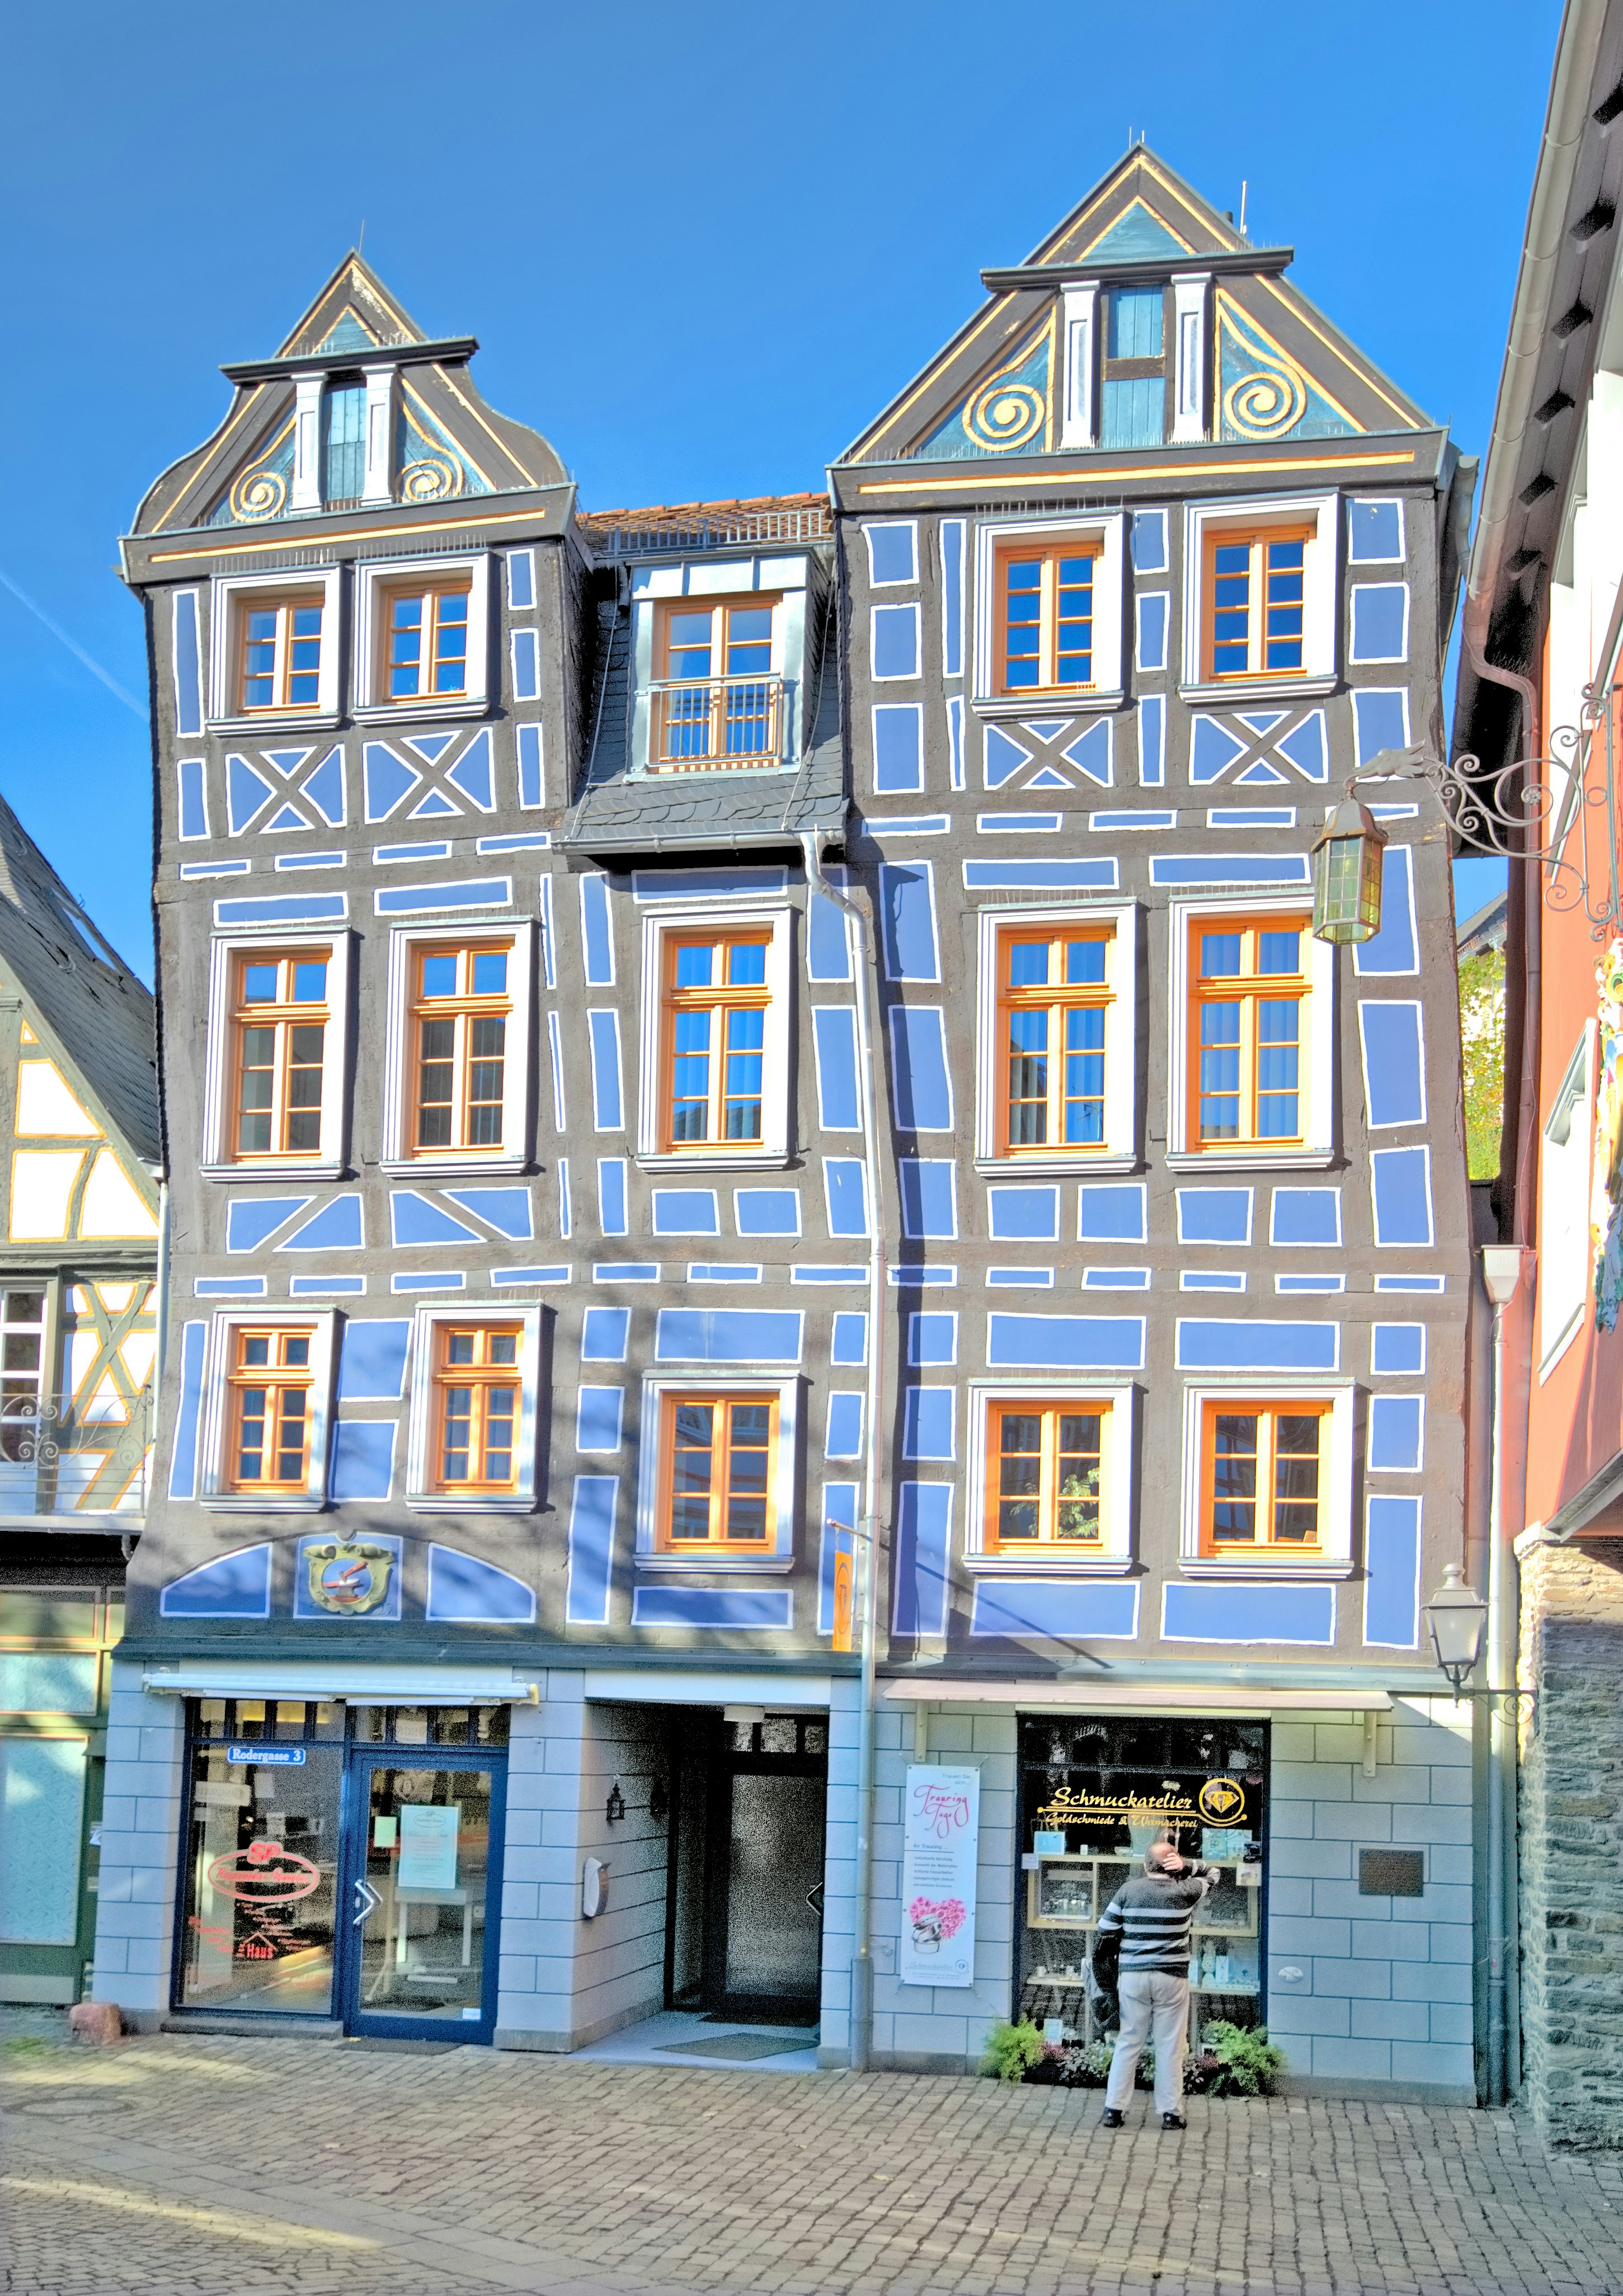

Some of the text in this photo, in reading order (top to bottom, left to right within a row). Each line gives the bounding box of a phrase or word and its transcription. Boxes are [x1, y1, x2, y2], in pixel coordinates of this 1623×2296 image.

[233, 1748, 301, 1762] Rodergasse 3
[912, 1784, 968, 1827] Trauring
[1050, 1786, 1192, 1809] Schmuckatelier
[924, 1802, 961, 1838] Tage
[1045, 1812, 1197, 1828] Goldschmiede & Uhrmacherei
[247, 1842, 281, 1863] SP
[247, 1943, 274, 1959] Haus
